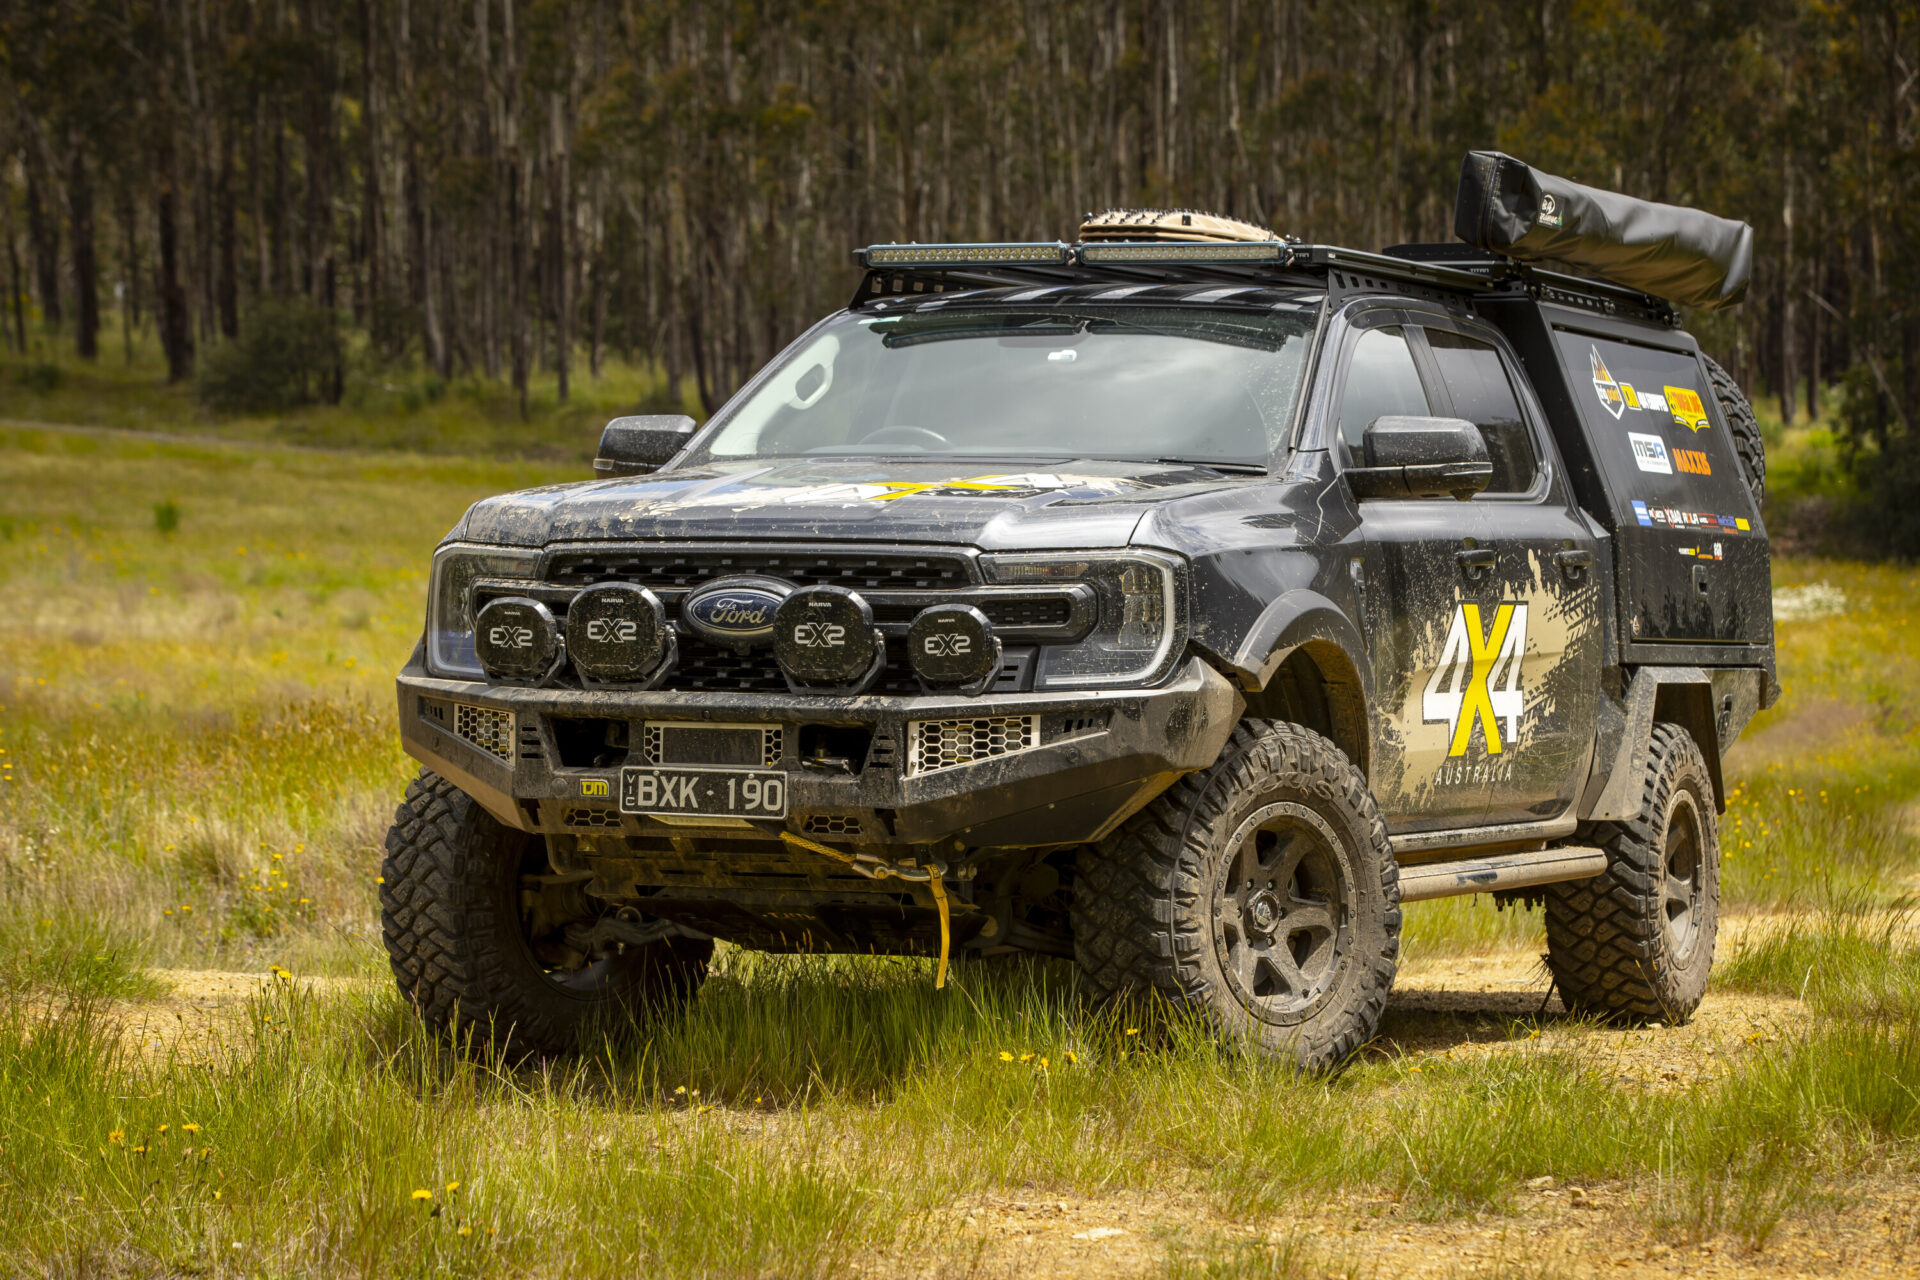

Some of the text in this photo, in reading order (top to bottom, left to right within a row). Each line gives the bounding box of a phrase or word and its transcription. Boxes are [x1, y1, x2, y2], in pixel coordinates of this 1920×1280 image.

[1672, 448, 1712, 476] MAXXIS
[710, 598, 766, 625] Ford
[490, 626, 534, 649] EX2
[587, 618, 637, 643] EX2
[794, 622, 845, 648] EX2
[924, 633, 971, 657] EX2
[1422, 603, 1529, 757] 4X4
[1435, 764, 1513, 786] AUSTRALIA
[638, 775, 783, 812] BXK 190
